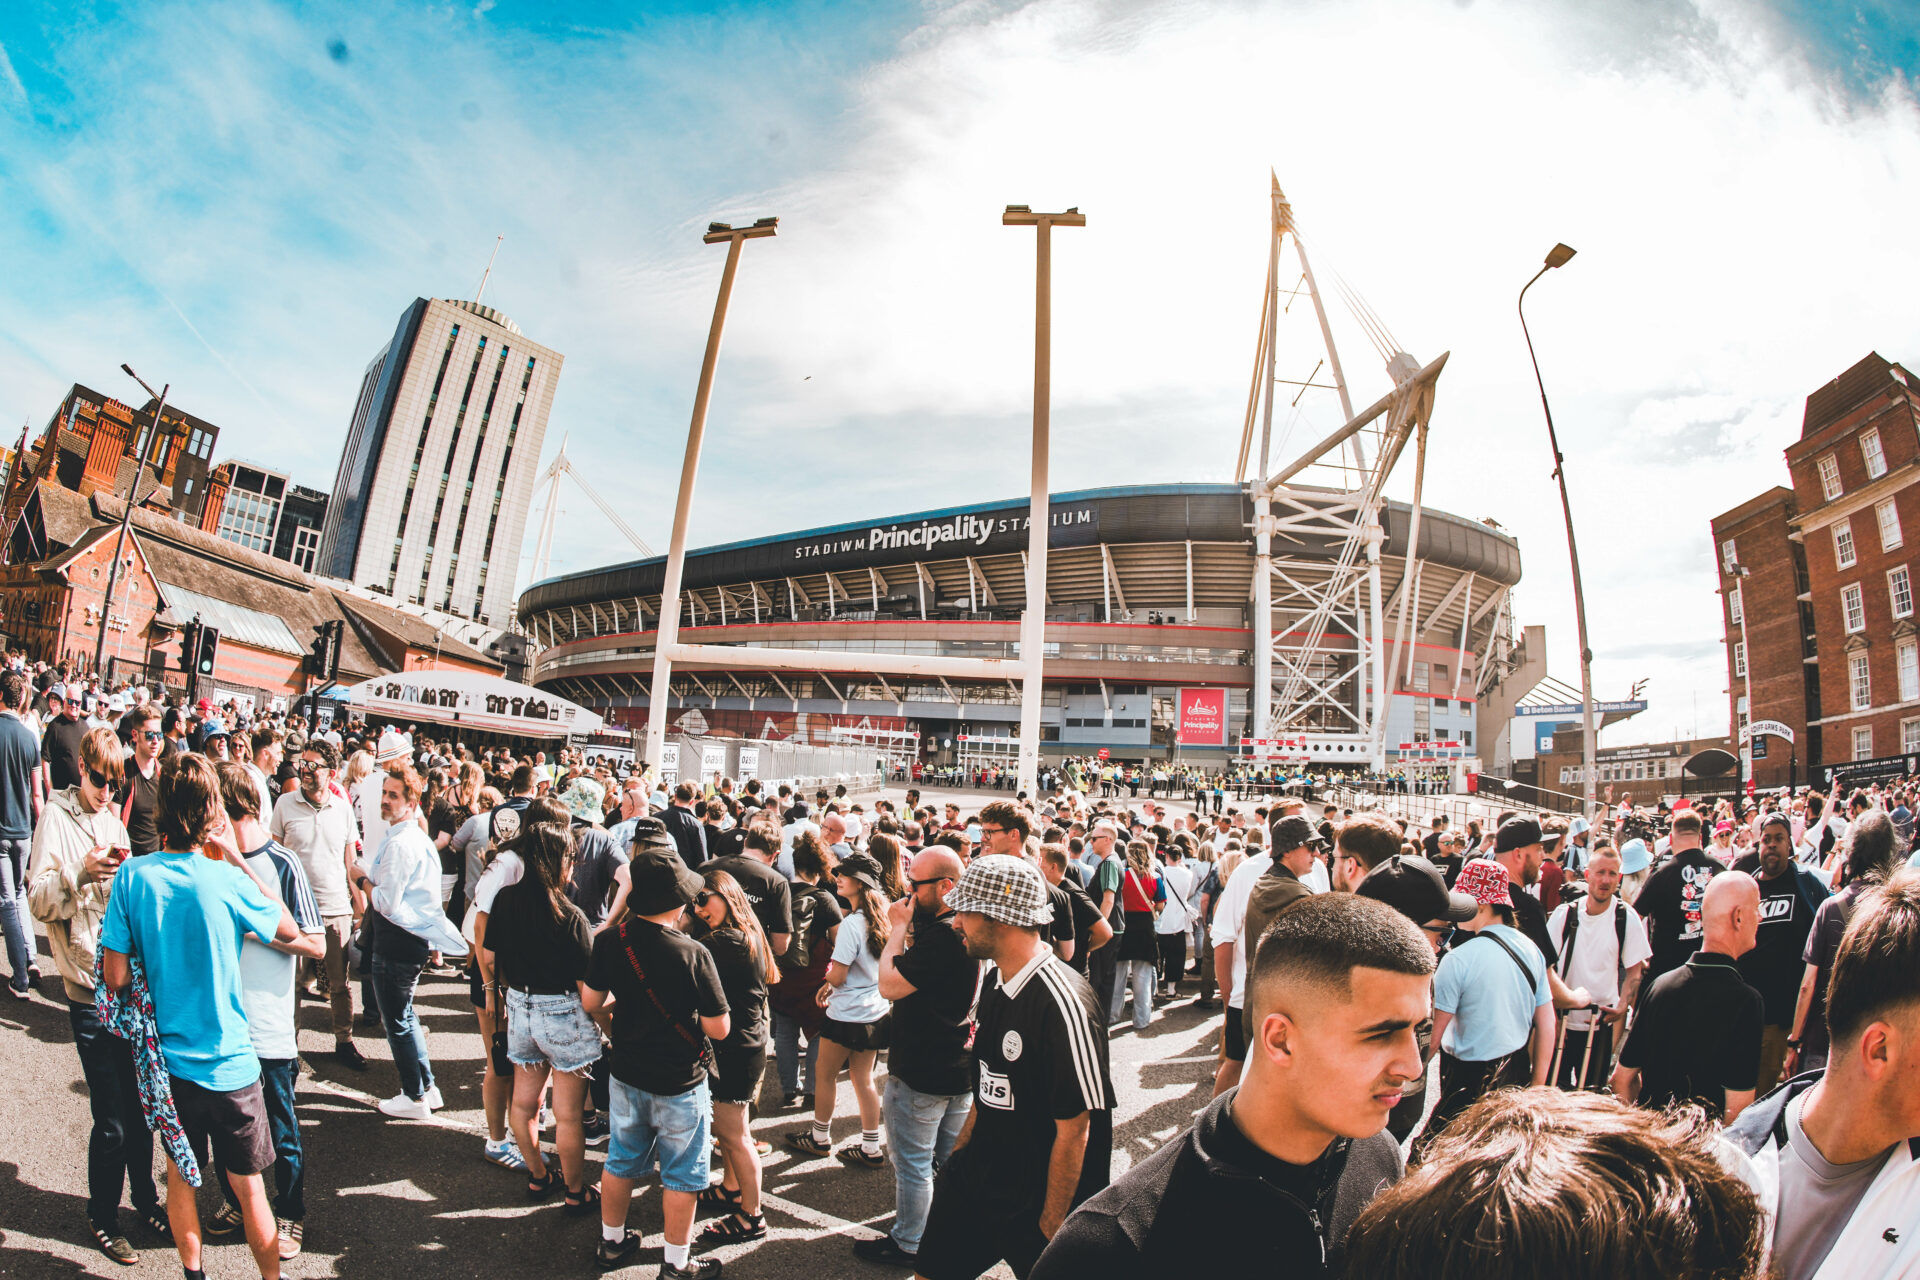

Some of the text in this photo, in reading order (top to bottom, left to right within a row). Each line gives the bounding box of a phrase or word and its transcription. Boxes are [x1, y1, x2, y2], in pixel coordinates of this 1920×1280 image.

[795, 510, 1091, 558] STADIWM Principality STAIUM
[1599, 703, 1620, 711] Beton
[1621, 702, 1641, 710] Bauen
[1183, 721, 1219, 731] Principality
[586, 754, 632, 771] ois
[705, 752, 724, 764] oasis
[741, 753, 756, 765] oasis
